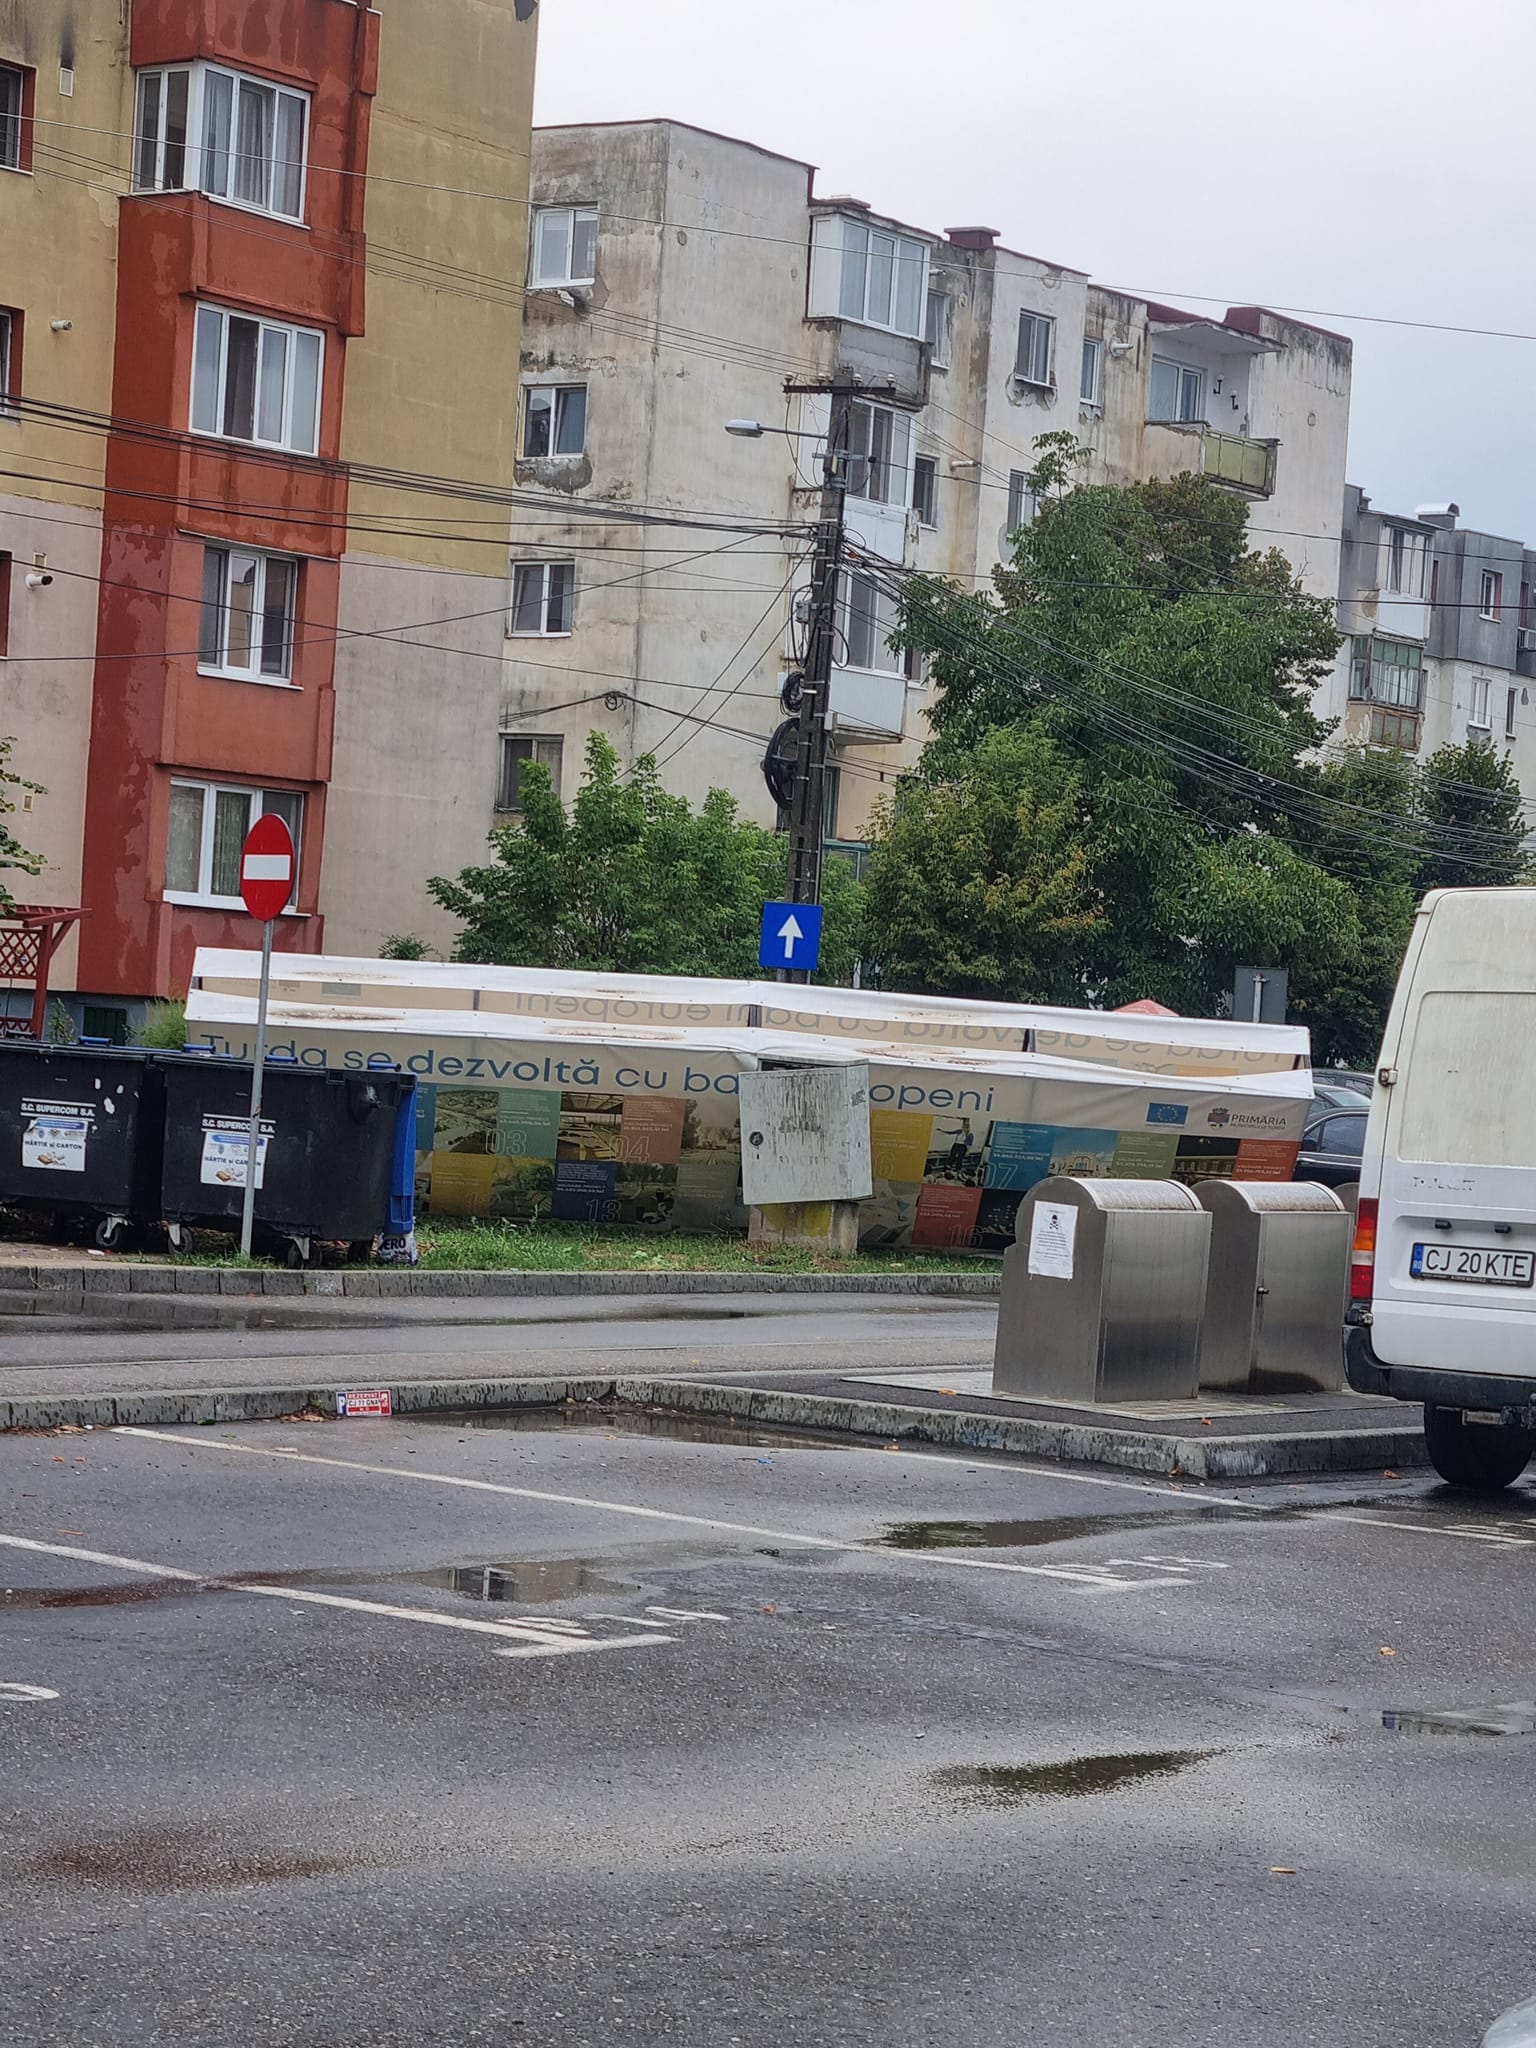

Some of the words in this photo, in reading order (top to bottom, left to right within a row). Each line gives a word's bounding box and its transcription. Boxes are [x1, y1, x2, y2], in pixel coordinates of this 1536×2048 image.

[200, 1034, 328, 1067] Tuda
[407, 1049, 601, 1086] dezvoltă
[615, 1067, 667, 1090] cu
[684, 1066, 739, 1095] ba
[868, 1084, 995, 1112] openi
[36, 1104, 79, 1115] SUPERCOM
[217, 1121, 251, 1131] SUPERCO
[486, 1129, 527, 1157] 03
[610, 1134, 650, 1163] 04
[235, 1159, 262, 1167] CARN
[1426, 1249, 1451, 1271] CJ
[1457, 1252, 1481, 1274] 20
[1485, 1253, 1529, 1278] KTE
